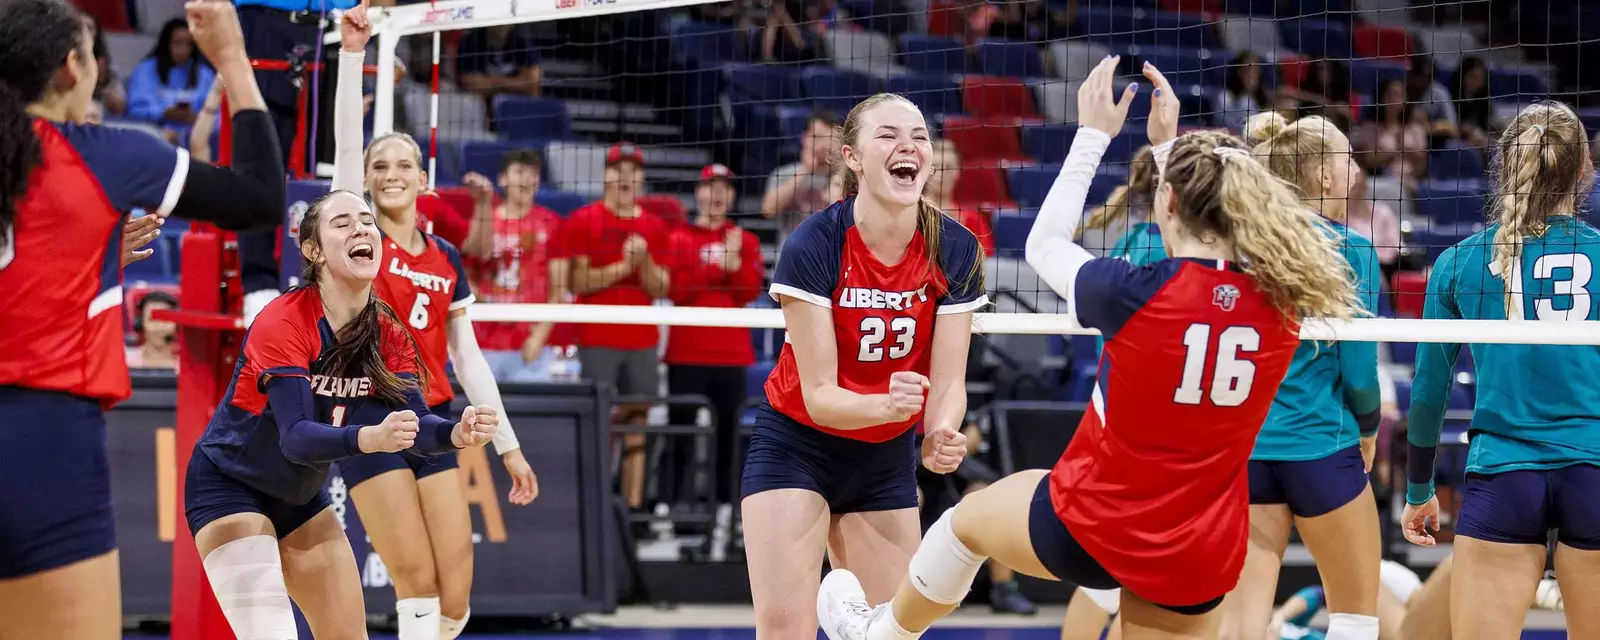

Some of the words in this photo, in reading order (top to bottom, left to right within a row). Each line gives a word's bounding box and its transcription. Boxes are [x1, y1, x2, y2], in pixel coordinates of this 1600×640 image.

[408, 292, 431, 330] 6
[839, 282, 929, 311] LIBERTY
[857, 316, 917, 362] 23
[1173, 322, 1261, 407] 16
[311, 374, 373, 398] FLAME
[332, 405, 346, 427] 1
